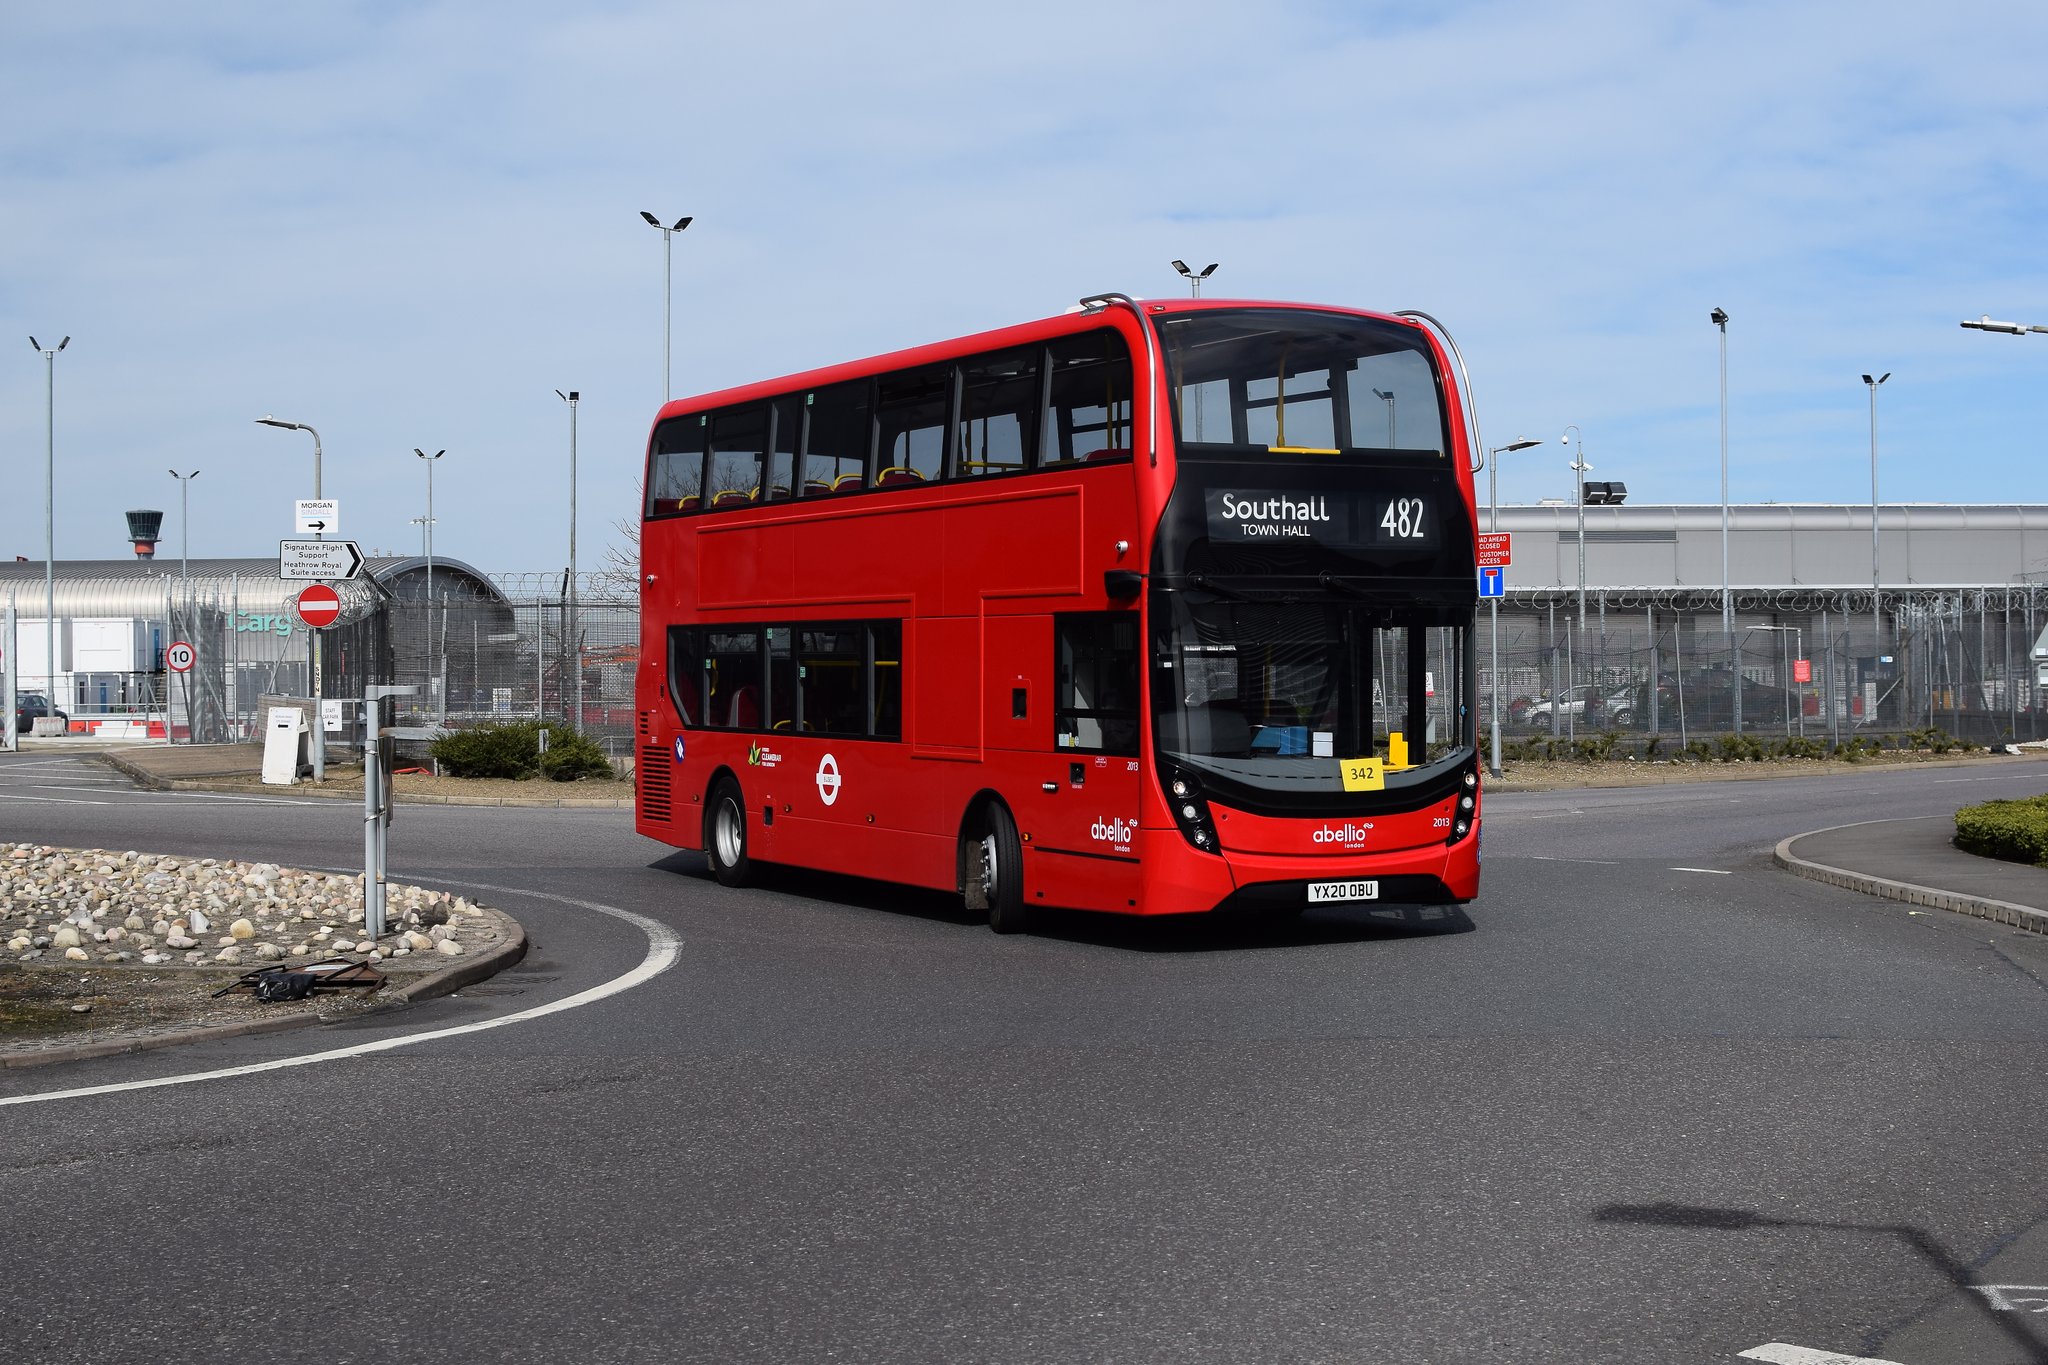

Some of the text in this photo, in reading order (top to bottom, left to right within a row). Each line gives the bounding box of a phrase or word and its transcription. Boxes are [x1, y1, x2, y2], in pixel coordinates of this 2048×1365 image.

[1221, 493, 1330, 521] Southall
[1380, 498, 1424, 538] 482
[1241, 524, 1310, 537] TOWN HALL
[284, 544, 343, 552] Signature Flight
[322, 562, 342, 570] Royal
[172, 651, 189, 663] 10
[1127, 761, 1139, 771] 2013
[1351, 767, 1374, 780] 342
[1433, 818, 1450, 827] 2013
[1091, 816, 1131, 843] abellio
[1312, 824, 1366, 843] abellio
[1114, 844, 1130, 852] london
[1314, 883, 1373, 899] YX20 OBU
